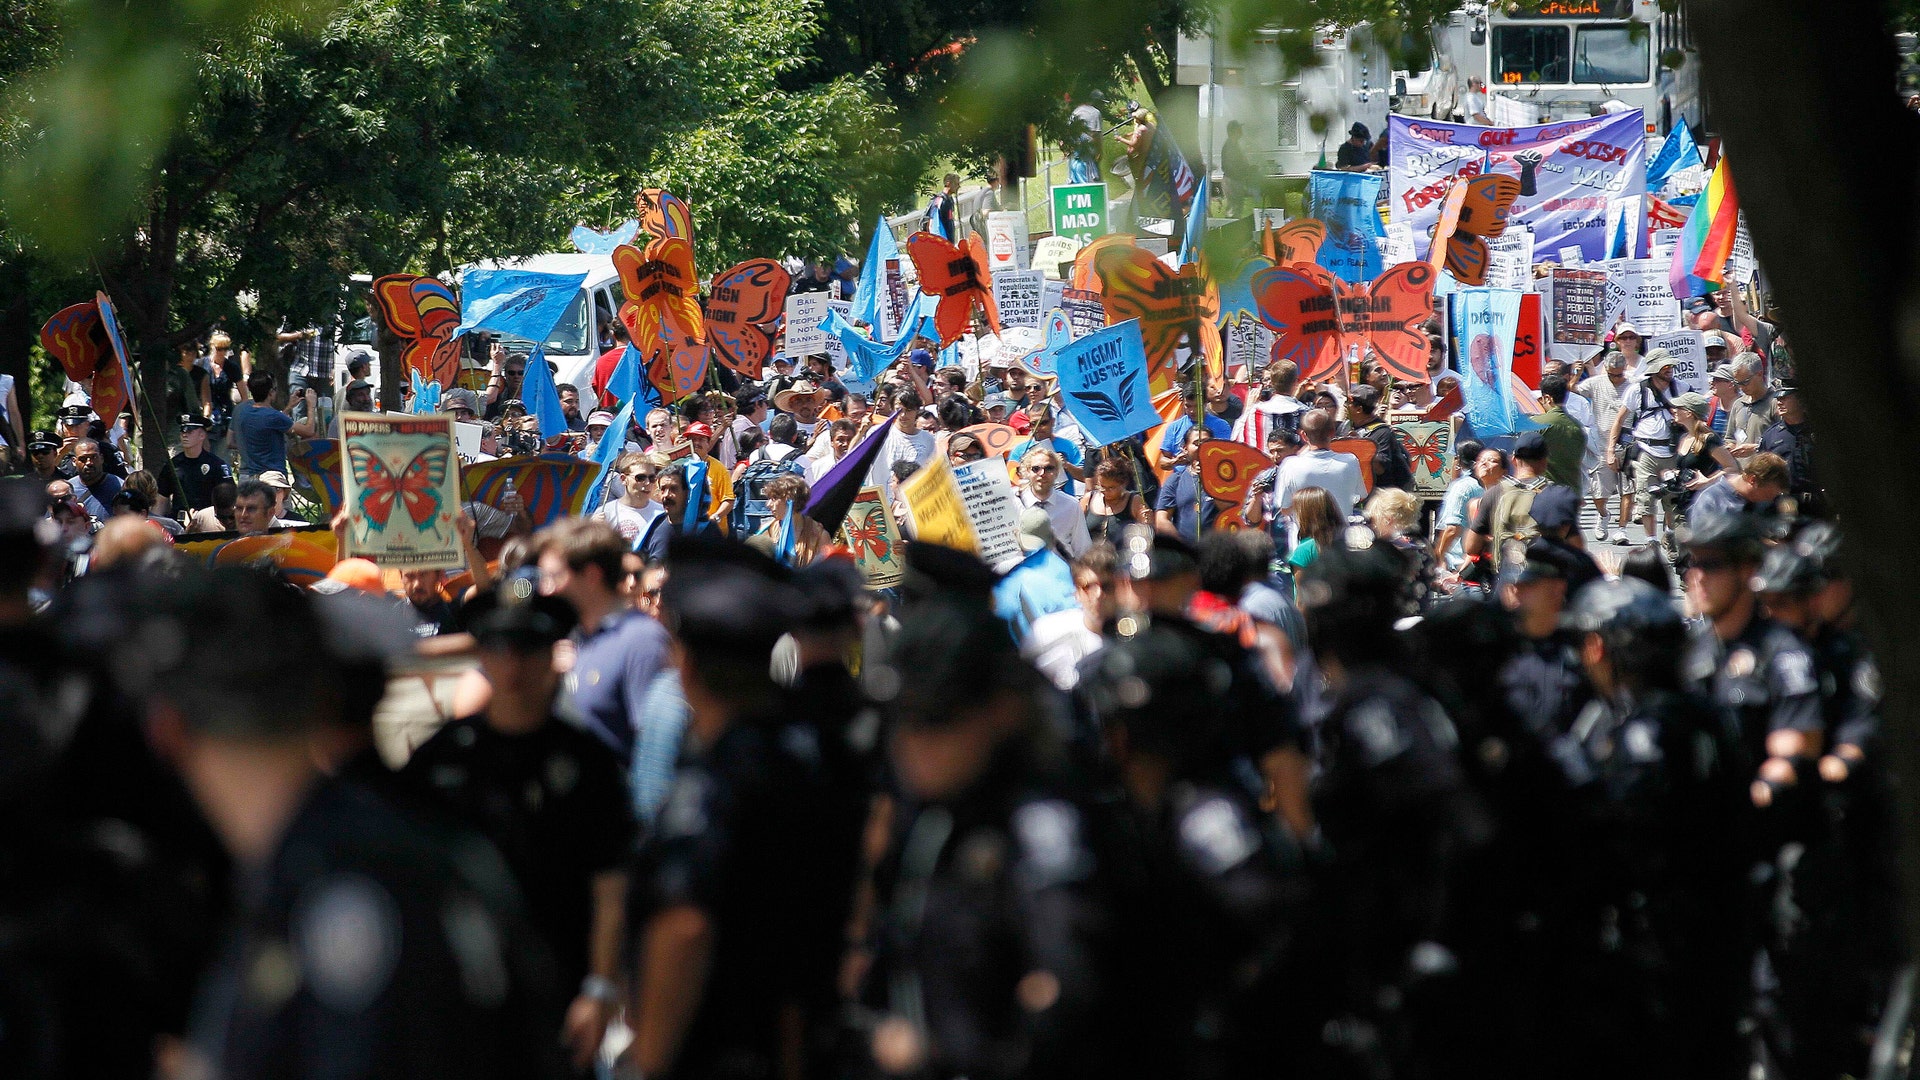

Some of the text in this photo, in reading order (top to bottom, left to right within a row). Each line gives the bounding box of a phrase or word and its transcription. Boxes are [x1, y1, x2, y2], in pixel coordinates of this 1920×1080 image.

[1408, 123, 1455, 145] COME
[1559, 137, 1629, 166] SEXISM
[1542, 160, 1565, 174] AND
[1067, 193, 1092, 209] I'M
[1062, 213, 1100, 229] MAD
[1562, 216, 1606, 231] iacbosto
[1379, 244, 1399, 256] ANIZE
[1489, 243, 1522, 252] ARGAINING
[1330, 259, 1344, 267] NO
[1000, 283, 1039, 291] republicans:
[710, 285, 740, 303] TION
[1576, 296, 1594, 304] BUILD
[790, 316, 823, 325] PEOPLE
[1567, 314, 1596, 325] POWER
[1513, 334, 1536, 358] CS
[1658, 337, 1696, 349] Chiquita
[1669, 347, 1689, 356] nana
[1674, 361, 1695, 374] NDS
[1674, 372, 1699, 380] ORISM
[346, 421, 357, 431] NO
[358, 422, 391, 433] PAPERS
[955, 465, 972, 478] MIT
